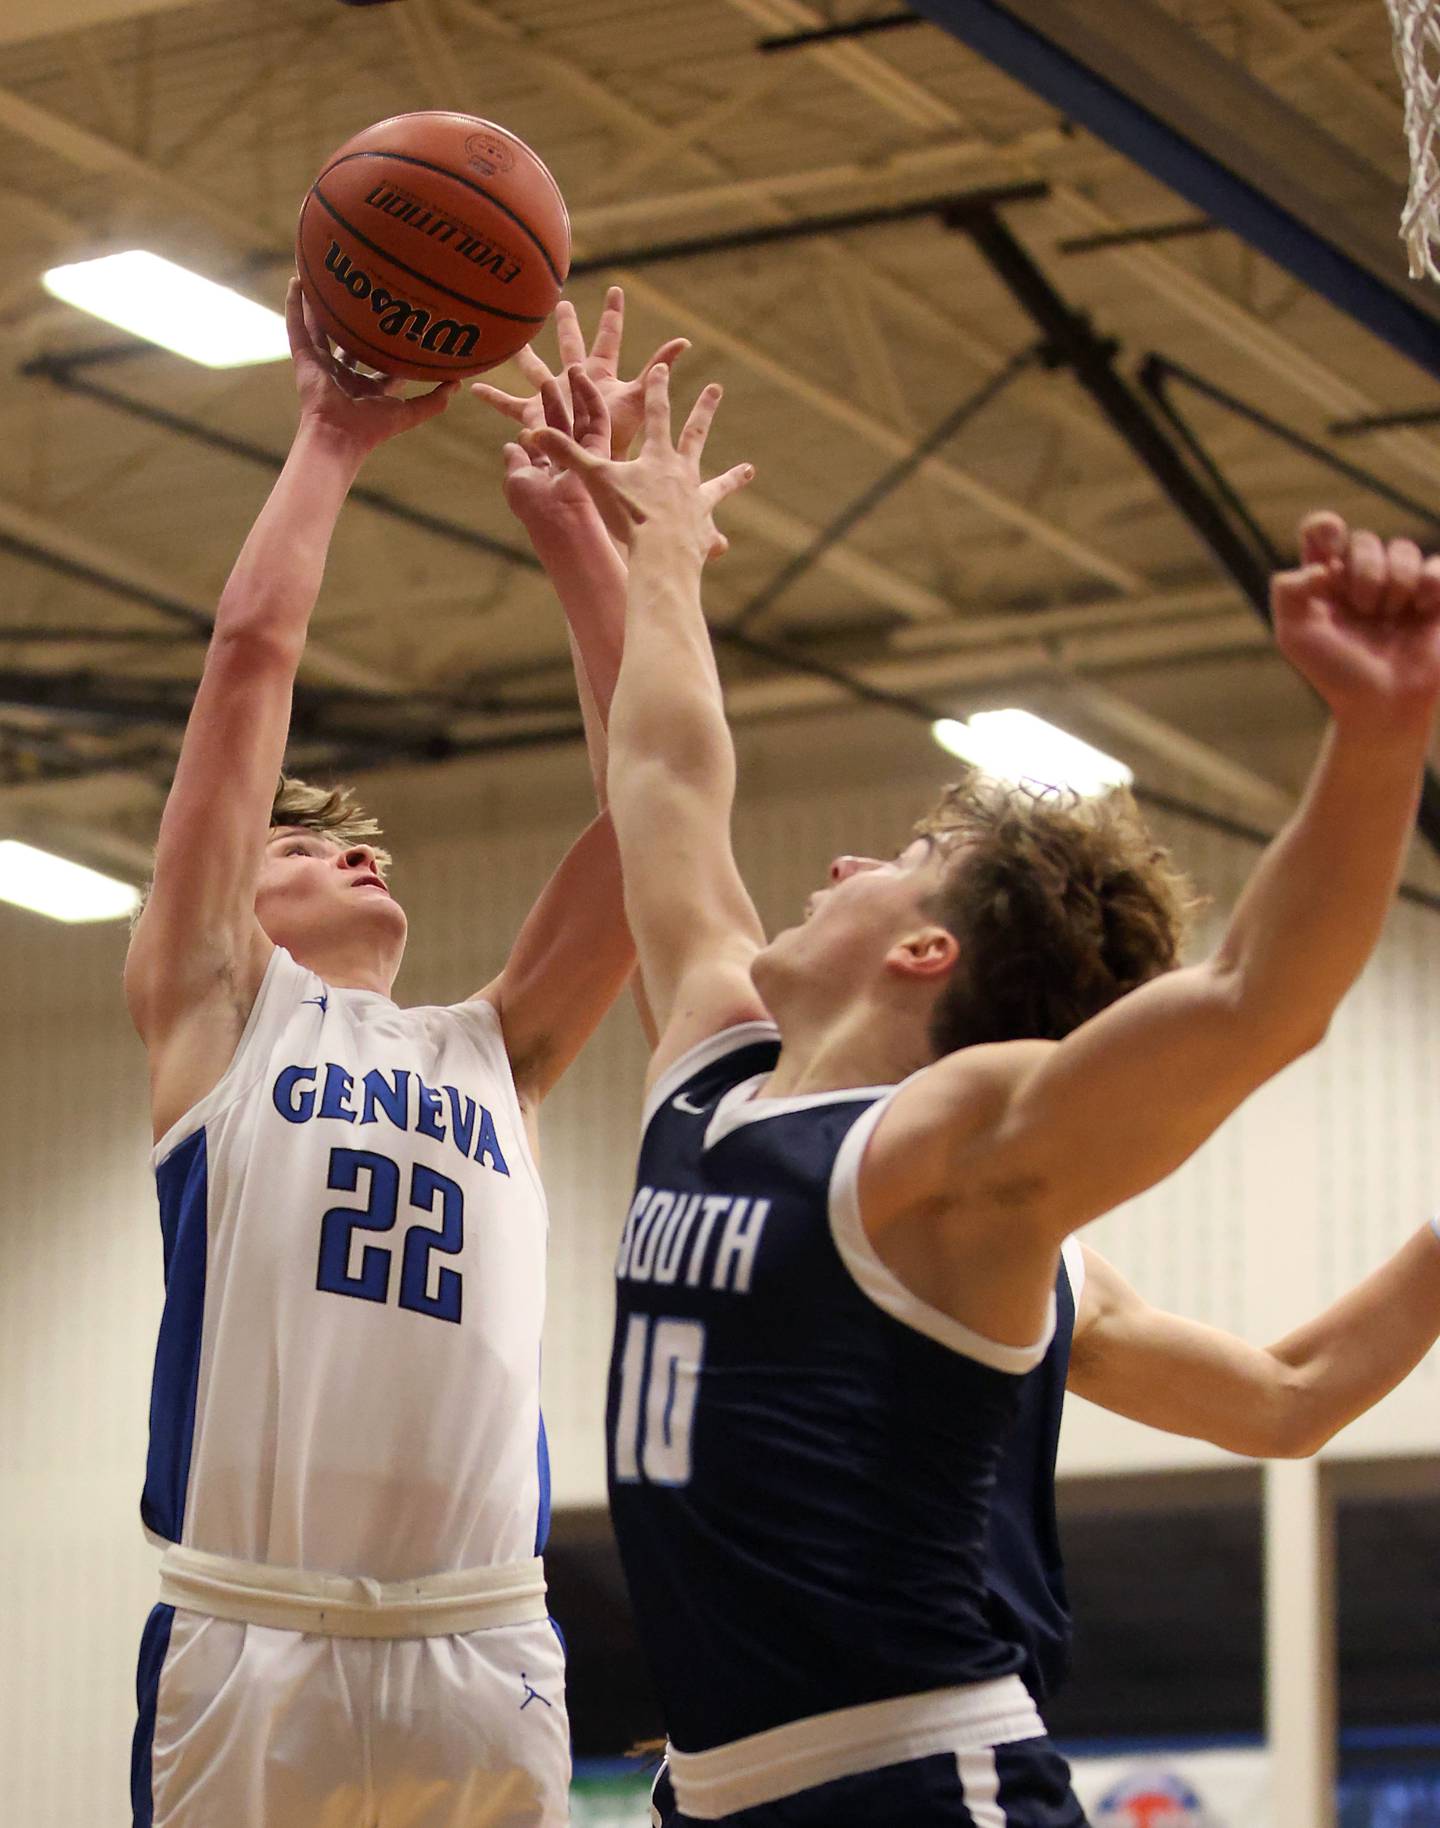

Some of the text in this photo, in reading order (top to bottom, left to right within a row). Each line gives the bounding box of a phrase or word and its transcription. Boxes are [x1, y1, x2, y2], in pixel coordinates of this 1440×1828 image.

[364, 186, 521, 284] EVOLUTION
[324, 240, 481, 358] Wilson
[272, 1062, 511, 1178] GENEVA
[316, 1147, 465, 1325] 22
[616, 1185, 772, 1295] SOUTH
[614, 1311, 706, 1488] 10
